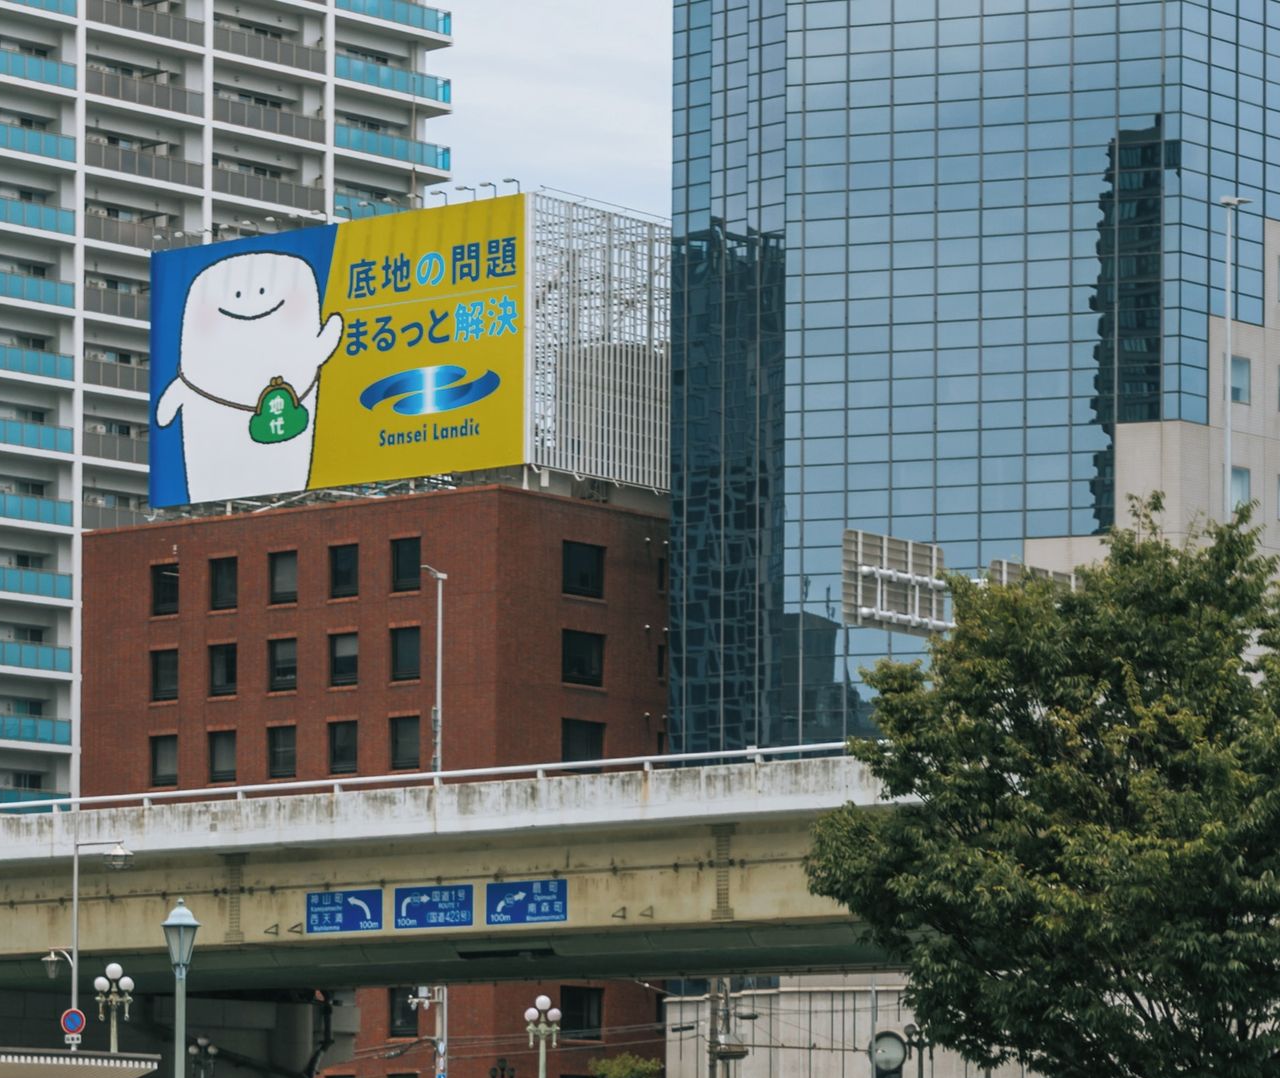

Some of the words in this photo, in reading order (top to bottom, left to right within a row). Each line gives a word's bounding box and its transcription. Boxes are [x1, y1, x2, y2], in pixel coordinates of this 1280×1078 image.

[347, 236, 517, 299] 底地の問題
[346, 295, 518, 356] まるっと解決
[268, 395, 285, 435] 地代
[379, 423, 427, 447] Sansei
[433, 417, 480, 440] Landic
[359, 920, 379, 929] 100m
[397, 918, 417, 927] 100m
[490, 913, 511, 922] 100m
